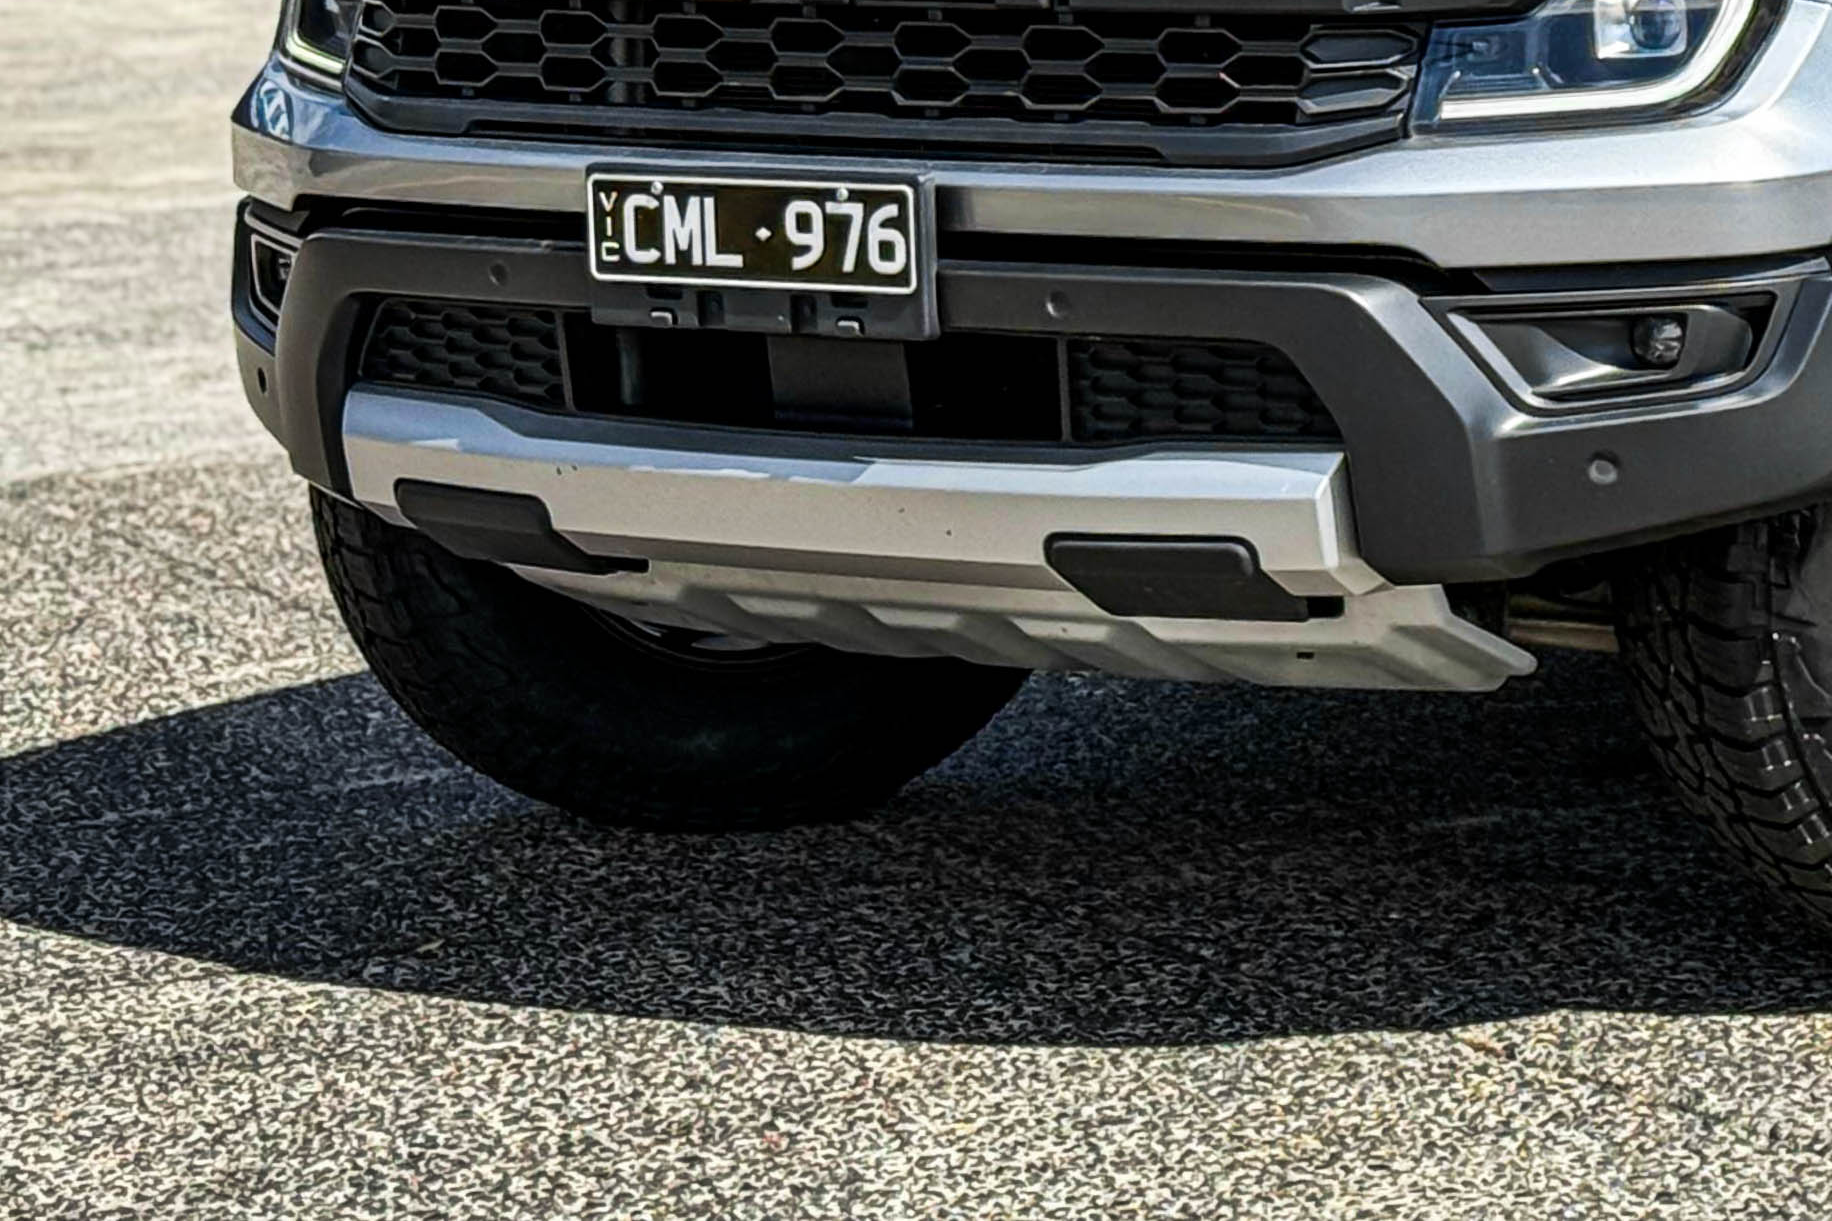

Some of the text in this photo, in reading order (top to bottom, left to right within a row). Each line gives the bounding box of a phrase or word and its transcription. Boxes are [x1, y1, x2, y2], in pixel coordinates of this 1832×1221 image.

[599, 190, 621, 263] VIC
[623, 193, 908, 276] CML 976
